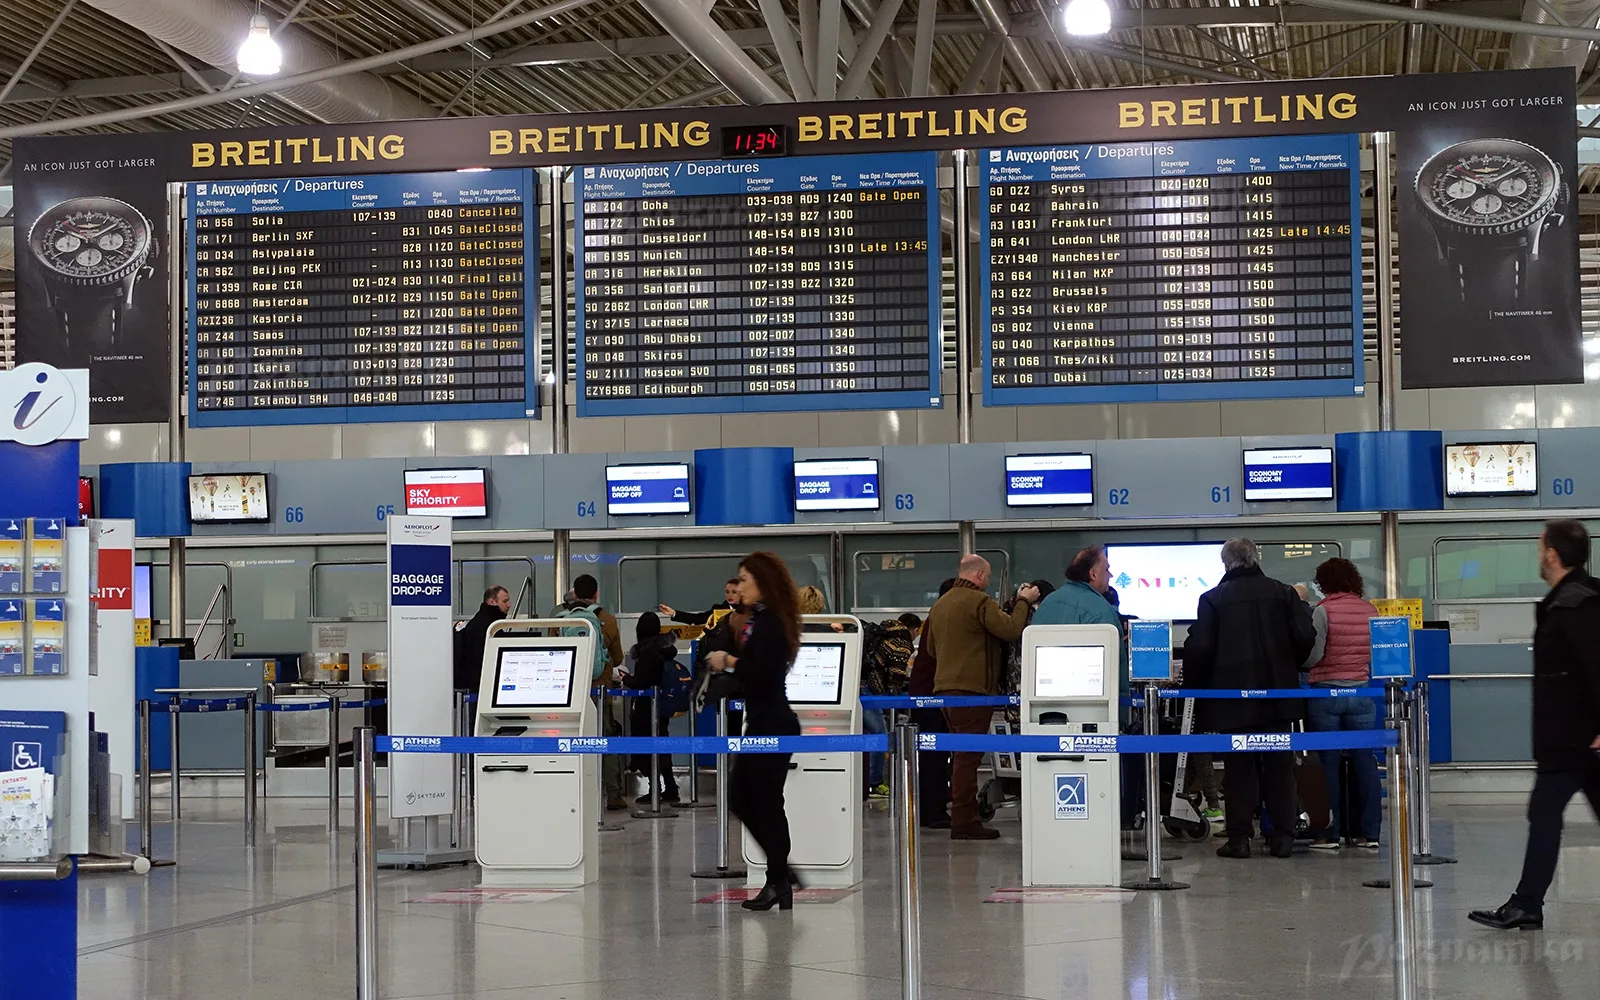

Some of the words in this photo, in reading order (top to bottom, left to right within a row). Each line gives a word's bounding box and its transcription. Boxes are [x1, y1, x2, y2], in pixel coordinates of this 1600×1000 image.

[1119, 92, 1358, 128] BREITLING
[1408, 103, 1423, 111] AN
[1429, 102, 1457, 110] ICON
[1462, 100, 1486, 109] JUST
[1492, 99, 1515, 107] GOT
[1520, 97, 1563, 106] LARGER
[798, 106, 1028, 142] BREITLING
[489, 120, 710, 155] BREITLING
[191, 134, 405, 168] BREITLING
[1098, 145, 1174, 159] Departures
[24, 163, 38, 171] AN
[41, 161, 66, 171] ICON
[70, 160, 91, 169] JUST
[94, 160, 115, 169] GOT
[118, 158, 156, 168] LARGER
[600, 166, 669, 180] Αναχωρήσεις
[688, 163, 759, 176] Departures
[211, 182, 277, 196] Αναχωρήσεις
[295, 180, 364, 194] Departures
[1052, 185, 1084, 193] Syros
[1246, 176, 1272, 185] 1400
[748, 196, 792, 205] 033-038
[828, 193, 853, 202] 1240
[860, 192, 886, 201] Gate
[893, 192, 920, 201] Open
[1052, 202, 1098, 211] Bahrain
[1246, 194, 1272, 203] 1415
[253, 217, 283, 225] Sofia
[353, 212, 396, 222] 107-139
[428, 210, 453, 218] 0840
[460, 206, 517, 217] Cancelled
[643, 218, 675, 226] Chios
[828, 210, 853, 219] 1300
[1052, 218, 1112, 228] Frankfurt
[253, 232, 289, 242] Berlin
[296, 231, 314, 240] SXF
[429, 226, 453, 235] 1045
[1052, 236, 1092, 244] London
[1100, 234, 1119, 243] LHR
[1247, 228, 1272, 237] 1425
[1281, 227, 1308, 236] Late
[1317, 225, 1350, 234] 14:45
[253, 248, 314, 259] Astypalaia
[829, 244, 853, 253] 1310
[861, 243, 886, 252] Late
[895, 241, 927, 250] 13:45
[253, 265, 296, 275] Beijing
[302, 264, 321, 272] PEK
[644, 267, 701, 277] Heraklion
[253, 281, 277, 291] Rome
[284, 281, 302, 289] CIA
[430, 275, 453, 284] 1140
[460, 274, 491, 283] Final
[499, 273, 523, 282] call
[644, 283, 701, 293] Santorini
[1053, 287, 1107, 296] Brussels
[1248, 280, 1273, 289] 1500
[253, 298, 309, 307] Amsterdam
[460, 291, 485, 300] Gate
[493, 290, 517, 299] Open
[644, 301, 682, 310] London
[690, 299, 708, 309] LHR
[253, 314, 302, 324] Kastoria
[430, 308, 453, 317] 1200
[460, 308, 486, 316] Gate
[493, 307, 517, 316] Open
[1054, 304, 1079, 313] Kiev
[644, 318, 689, 327] Larnaca
[830, 312, 854, 321] 1330
[1054, 321, 1094, 330] Vienna
[253, 331, 283, 340] Samos
[430, 325, 454, 333] 1215
[644, 334, 663, 343] Abu
[1054, 338, 1114, 348] Karpathos
[1249, 332, 1274, 341] 1510
[254, 347, 302, 356] Ioannina
[644, 351, 683, 360] Skiros
[1453, 355, 1531, 363] BREITLING.COM
[1054, 355, 1114, 364] Thes/niki
[254, 364, 290, 372] Ikaria
[254, 380, 309, 388] Zakinthos
[645, 384, 703, 394] Edinburgh
[831, 379, 855, 388] 1400
[254, 396, 302, 406] Istanbul
[431, 391, 454, 400] 1235
[410, 489, 430, 497] SKY
[1212, 486, 1231, 502] 61
[1553, 478, 1573, 495] 60
[410, 497, 459, 505] PRIORITY
[896, 494, 914, 510] 63
[1109, 489, 1129, 504] 62
[286, 507, 304, 522] 66
[376, 506, 394, 520] 65
[577, 501, 596, 517] 64
[393, 574, 444, 583] BAGGAGE
[393, 586, 442, 595] DROP-OFF
